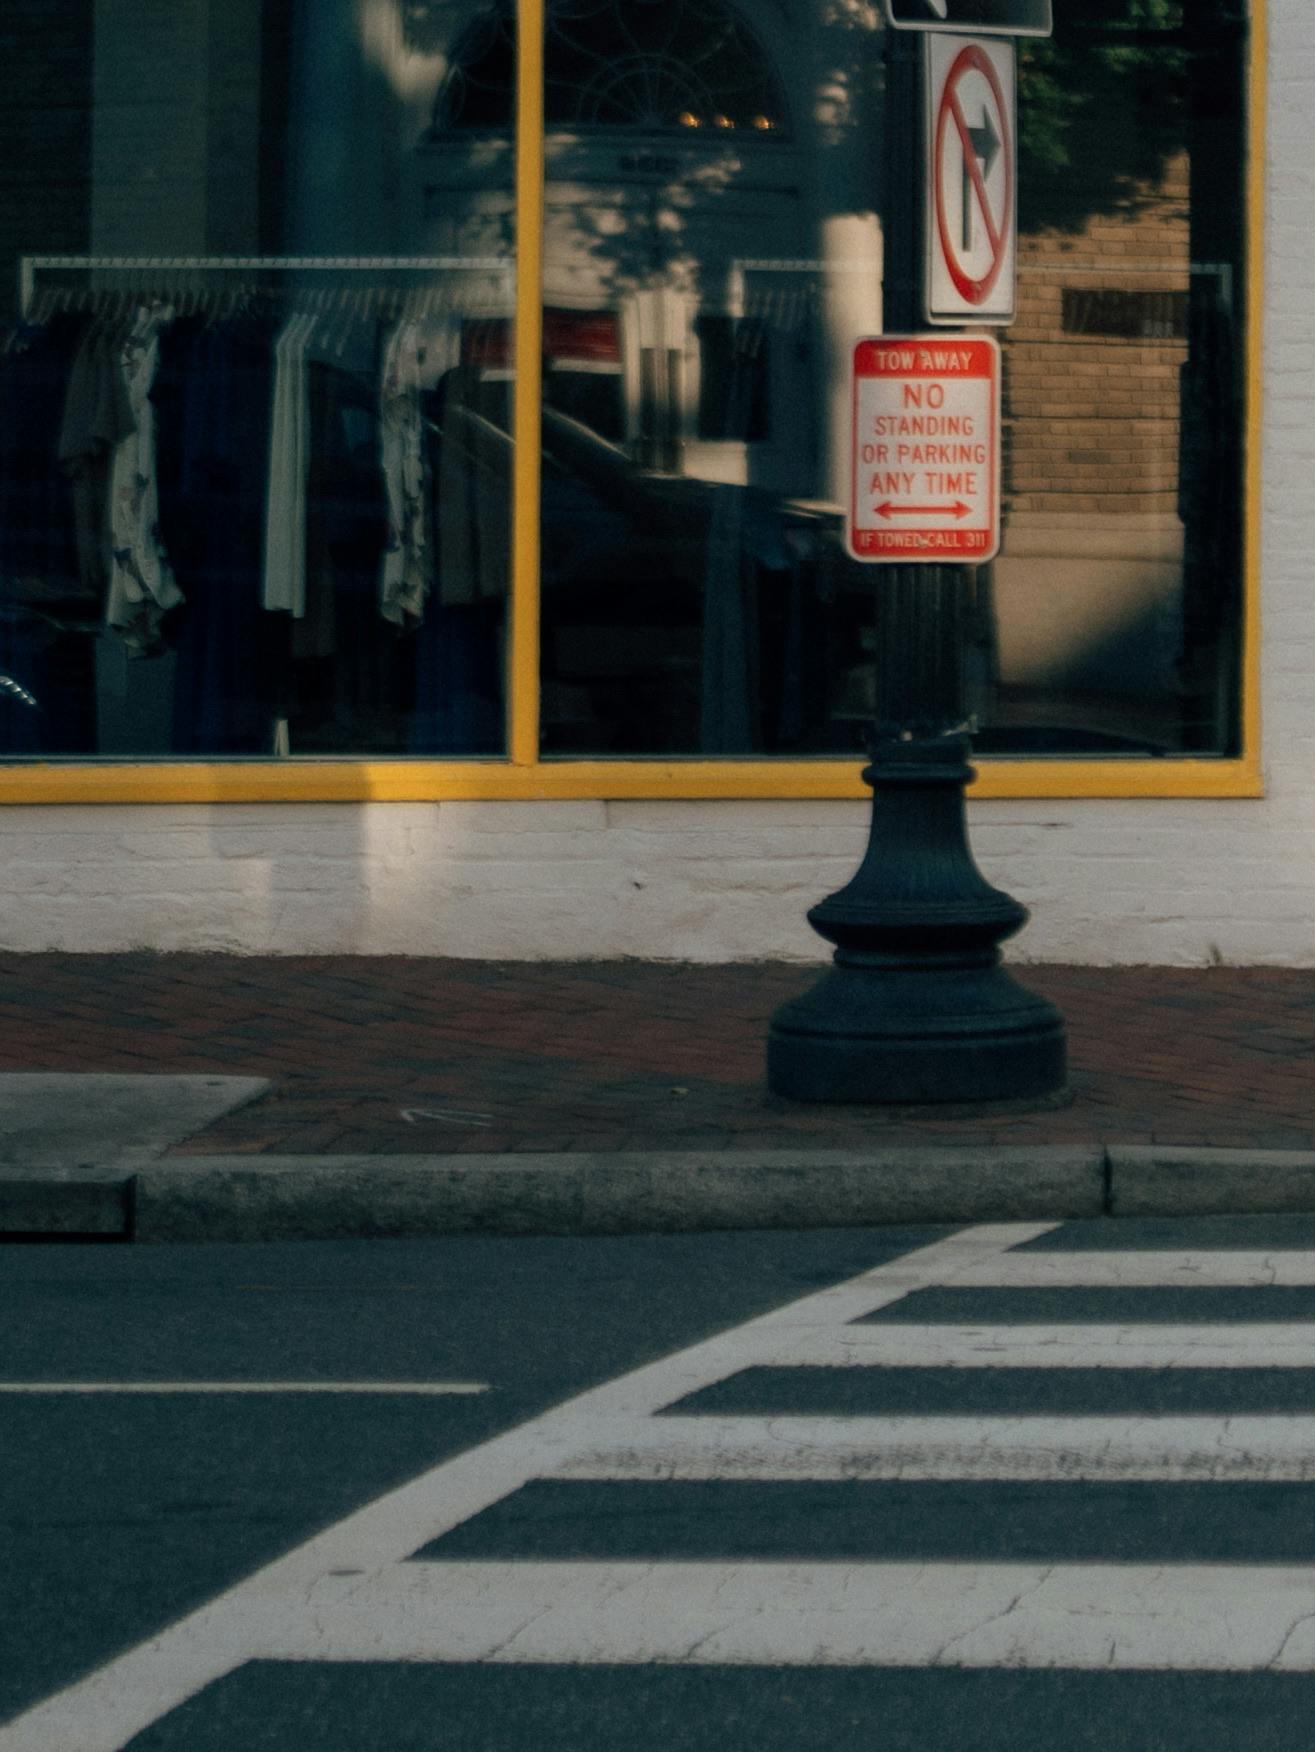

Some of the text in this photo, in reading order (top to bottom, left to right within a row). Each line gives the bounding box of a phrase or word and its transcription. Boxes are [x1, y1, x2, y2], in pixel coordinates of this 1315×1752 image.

[876, 350, 973, 371] TOW AWAY
[903, 383, 945, 409] NO
[874, 415, 974, 437] STANDING
[862, 444, 986, 465] OR PARKING
[870, 472, 977, 495] ANY TIME
[861, 532, 985, 547] IF TOWED CALL 311
